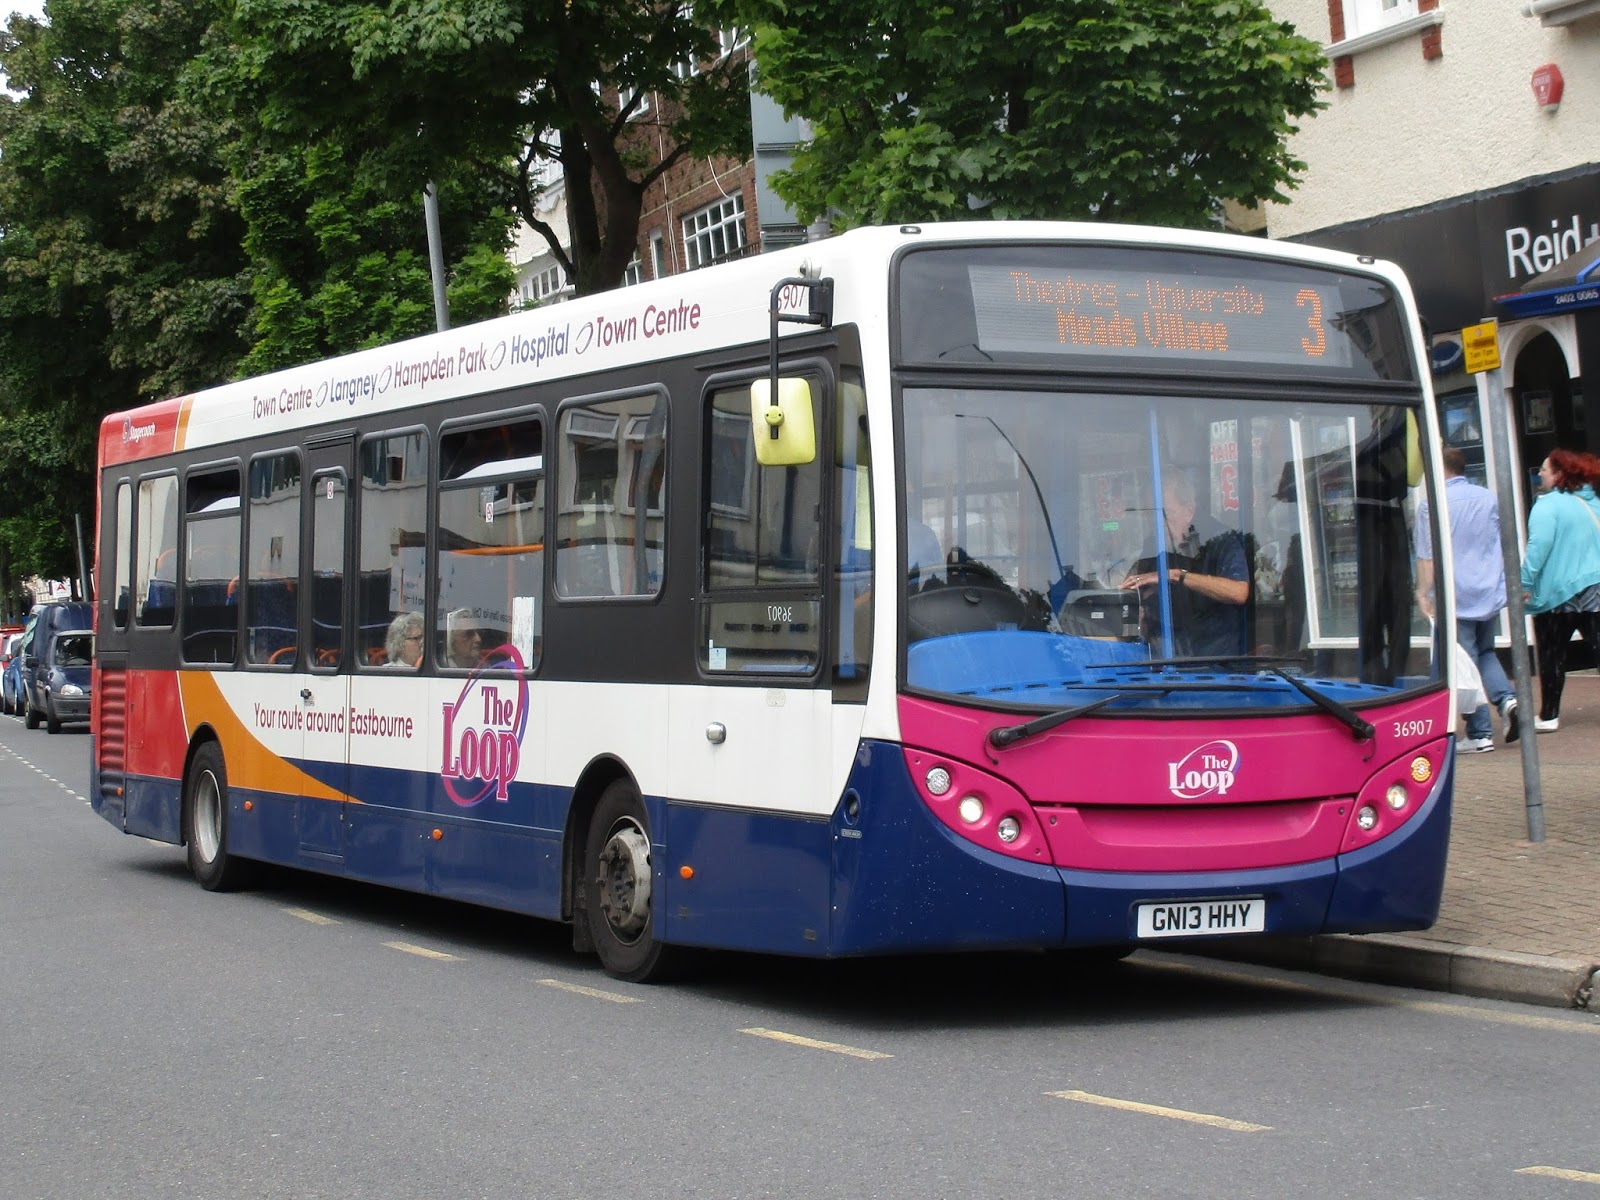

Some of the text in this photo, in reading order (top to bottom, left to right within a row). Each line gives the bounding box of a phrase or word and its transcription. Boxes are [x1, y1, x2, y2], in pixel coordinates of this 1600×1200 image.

[1010, 271, 1119, 307] Theatres
[1146, 280, 1265, 316] University
[596, 299, 701, 347] Town Centre
[1055, 307, 1230, 352] Meads Village
[1295, 288, 1327, 357] 3
[394, 342, 488, 389] Hampden Park
[510, 323, 570, 369] Hospital
[252, 387, 313, 420] Town Centre
[330, 374, 378, 405] Langney
[254, 702, 413, 739] Your route around Eastbourne
[481, 686, 514, 726] The
[1393, 719, 1433, 738] 36907
[441, 702, 520, 801] Loop
[1201, 754, 1229, 770] The
[1168, 762, 1235, 795] Loop
[1152, 903, 1252, 931] GN13 HHY
